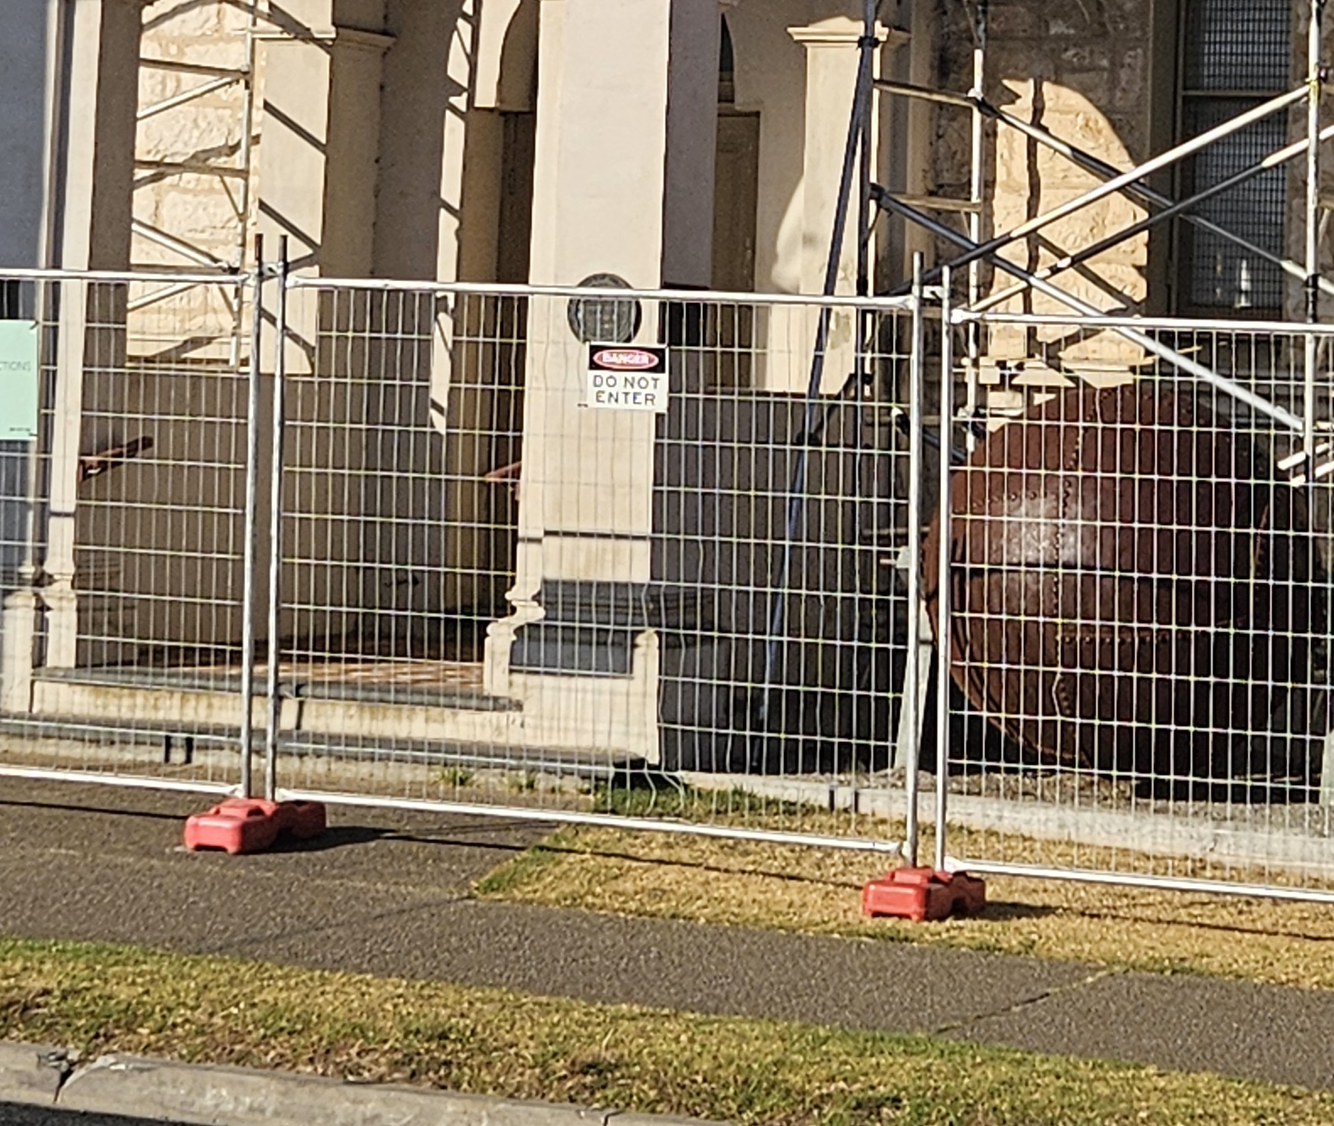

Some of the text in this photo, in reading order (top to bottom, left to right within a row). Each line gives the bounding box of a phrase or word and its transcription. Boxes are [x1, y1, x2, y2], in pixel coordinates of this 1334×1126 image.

[602, 352, 649, 365] DANGER
[593, 375, 660, 389] DO NOT
[595, 391, 656, 406] ENTER
